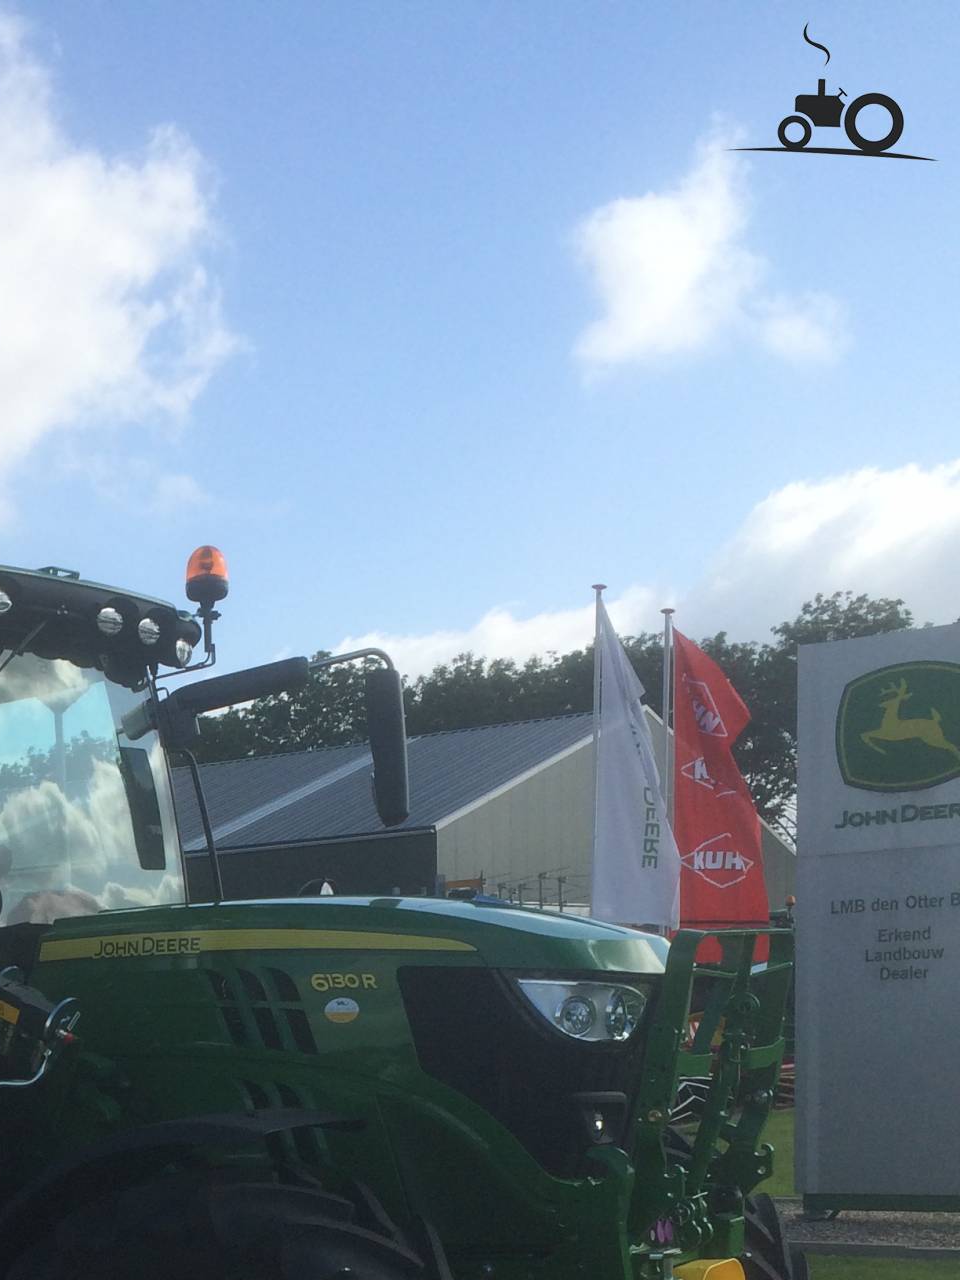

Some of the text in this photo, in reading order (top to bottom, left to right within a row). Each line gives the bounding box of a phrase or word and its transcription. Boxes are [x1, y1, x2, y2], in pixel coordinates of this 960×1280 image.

[834, 803, 960, 829] JOHN DEER
[831, 899, 865, 914] LMB
[871, 898, 899, 911] den
[905, 895, 944, 909] Otter
[878, 926, 931, 942] Erkend
[94, 937, 201, 956] JOHN DEERE
[865, 948, 944, 962] Landbouw
[311, 973, 378, 992] 6130 R
[880, 966, 928, 980] Dealer
